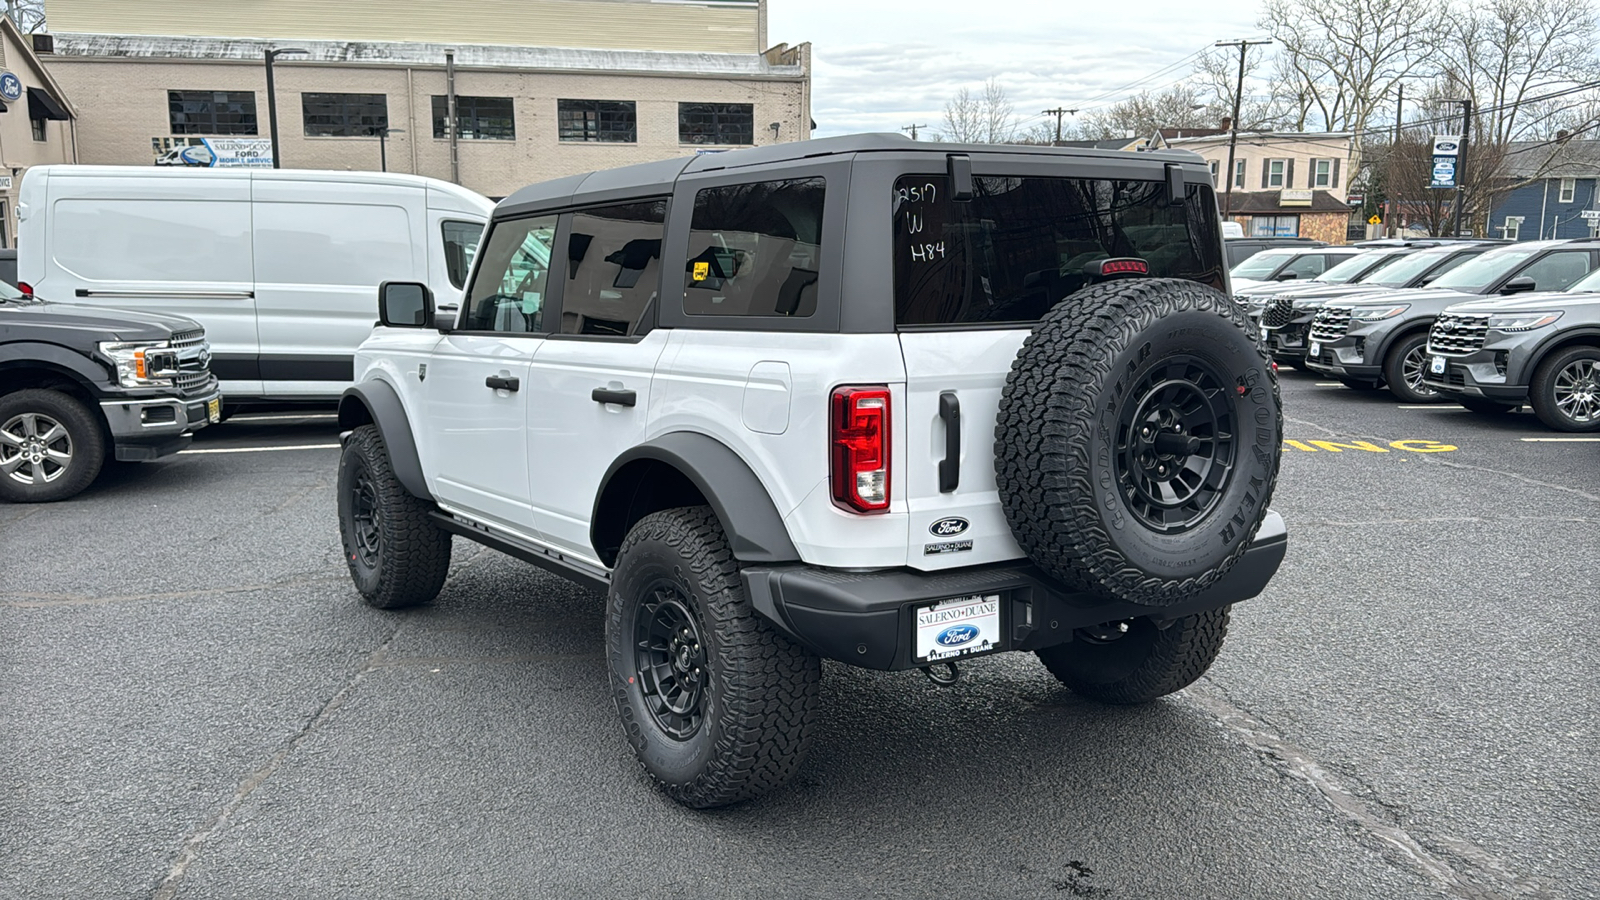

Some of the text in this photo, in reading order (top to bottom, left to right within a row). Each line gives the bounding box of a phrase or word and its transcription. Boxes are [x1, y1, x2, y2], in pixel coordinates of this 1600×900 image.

[4, 77, 19, 96] Ford
[898, 183, 936, 204] 2517
[906, 206, 923, 235] W
[910, 241, 945, 262] H84
[1282, 439, 1458, 453] ING
[918, 602, 997, 626] SALERNO DUANE
[944, 627, 972, 645] Ford
[926, 643, 994, 662] SALERNO DUANE
